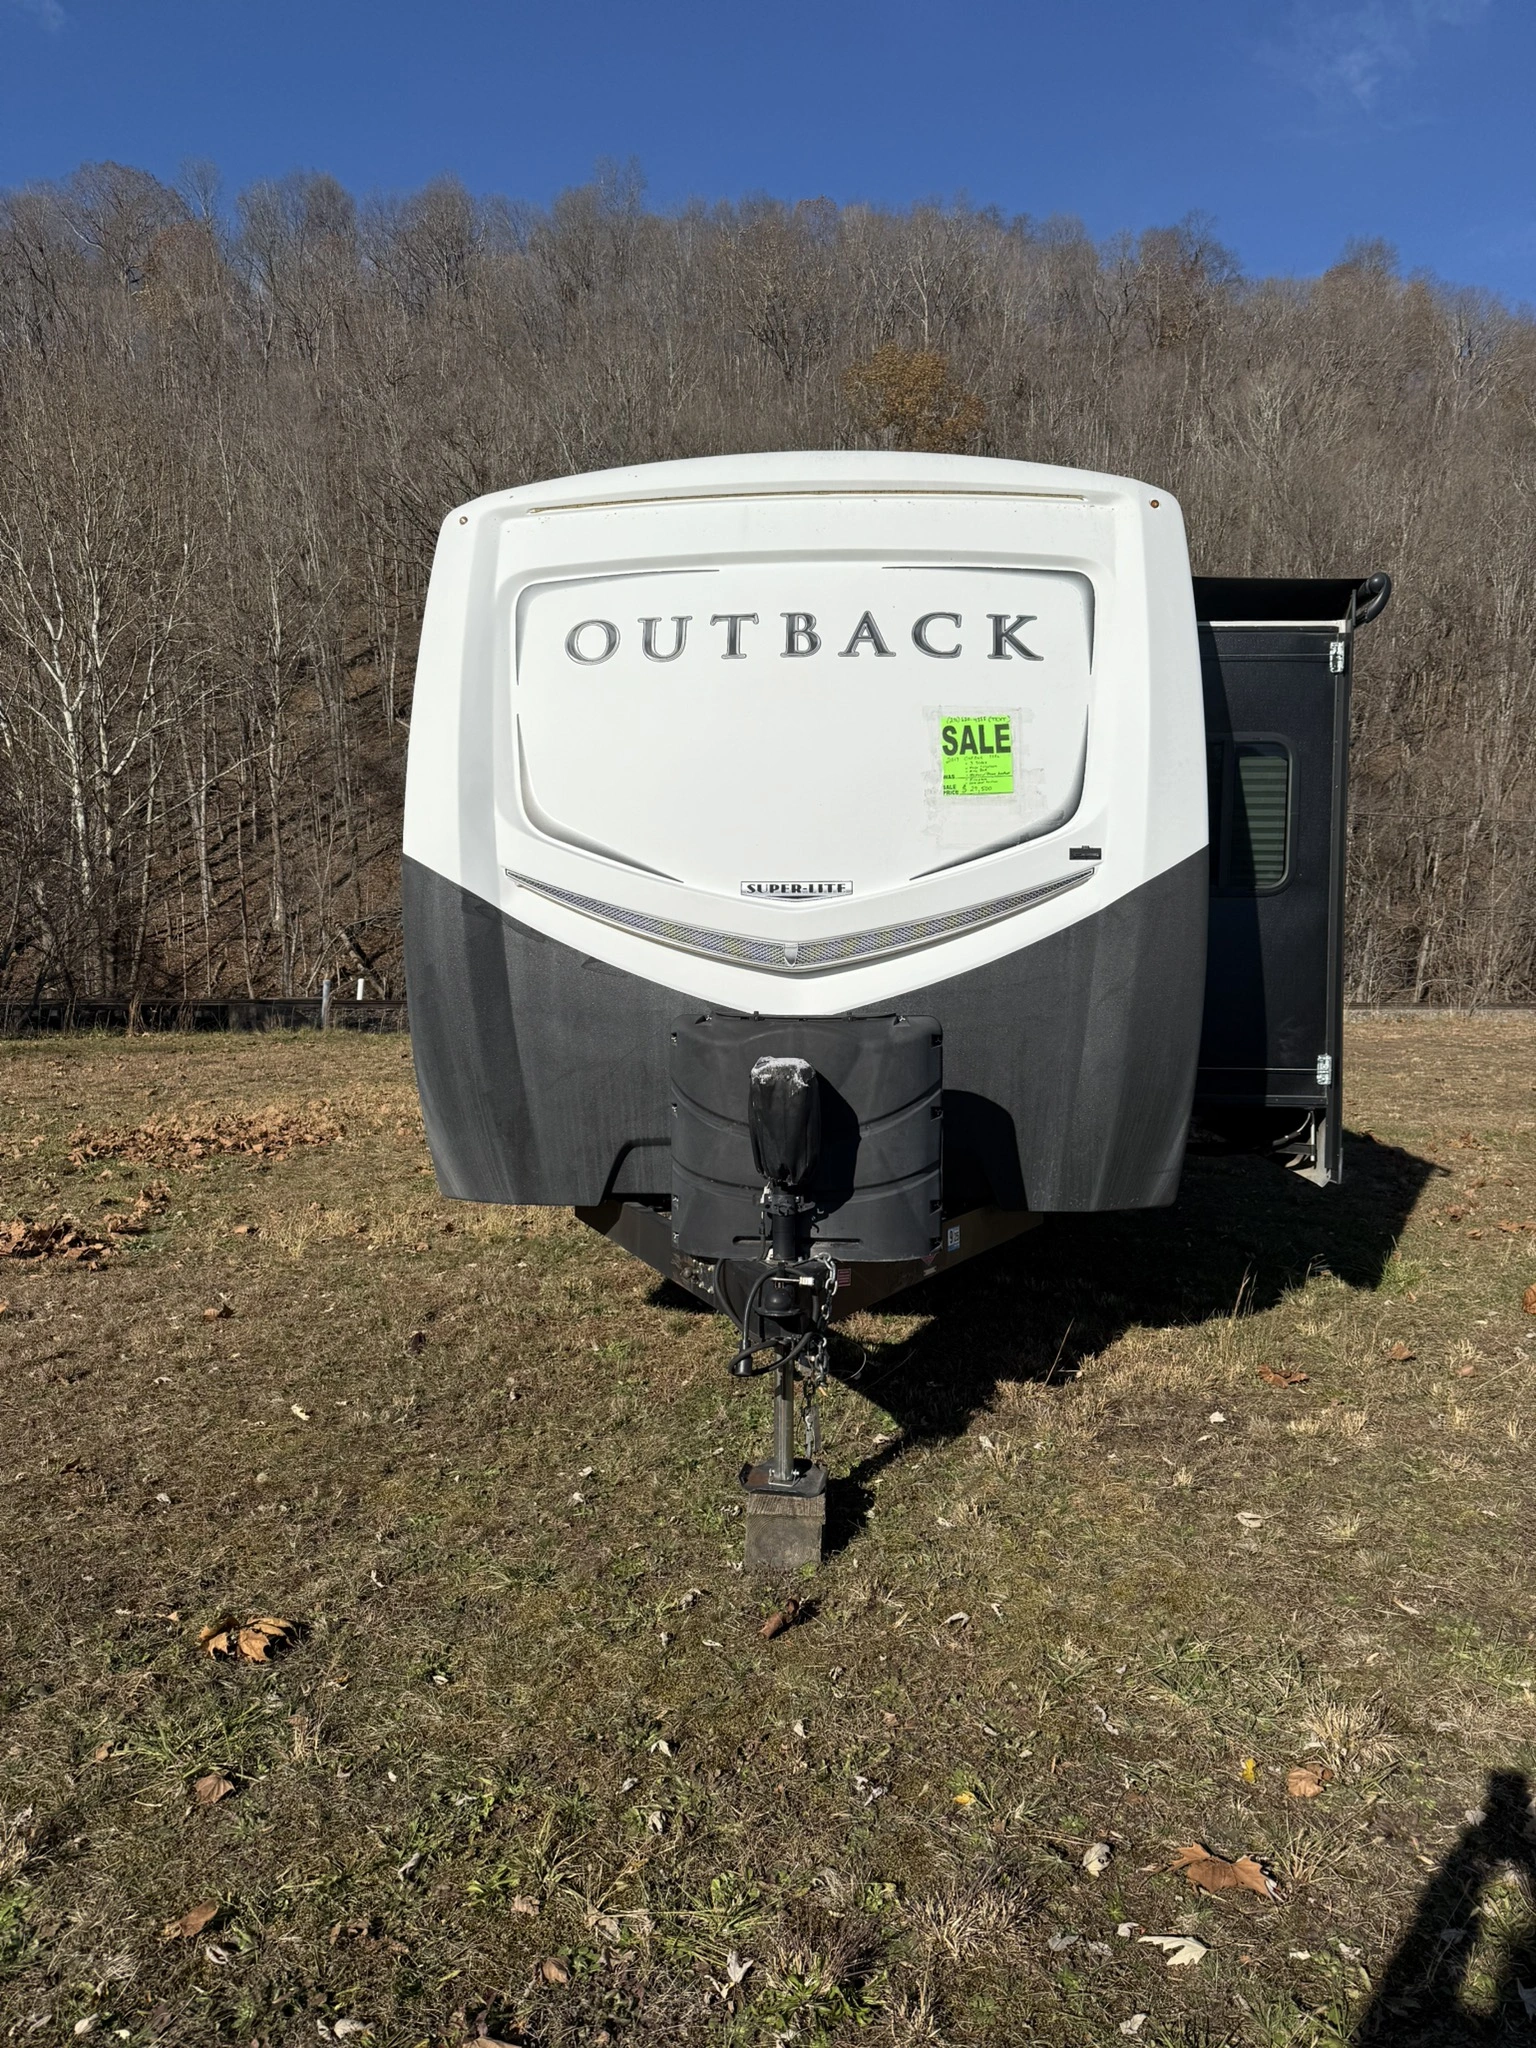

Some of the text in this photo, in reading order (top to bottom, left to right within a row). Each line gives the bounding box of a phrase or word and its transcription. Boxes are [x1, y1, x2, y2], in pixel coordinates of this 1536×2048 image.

[564, 610, 1044, 666] OUTBACK
[942, 724, 1011, 756] SALE
[746, 883, 847, 894] SUPER-LITE
